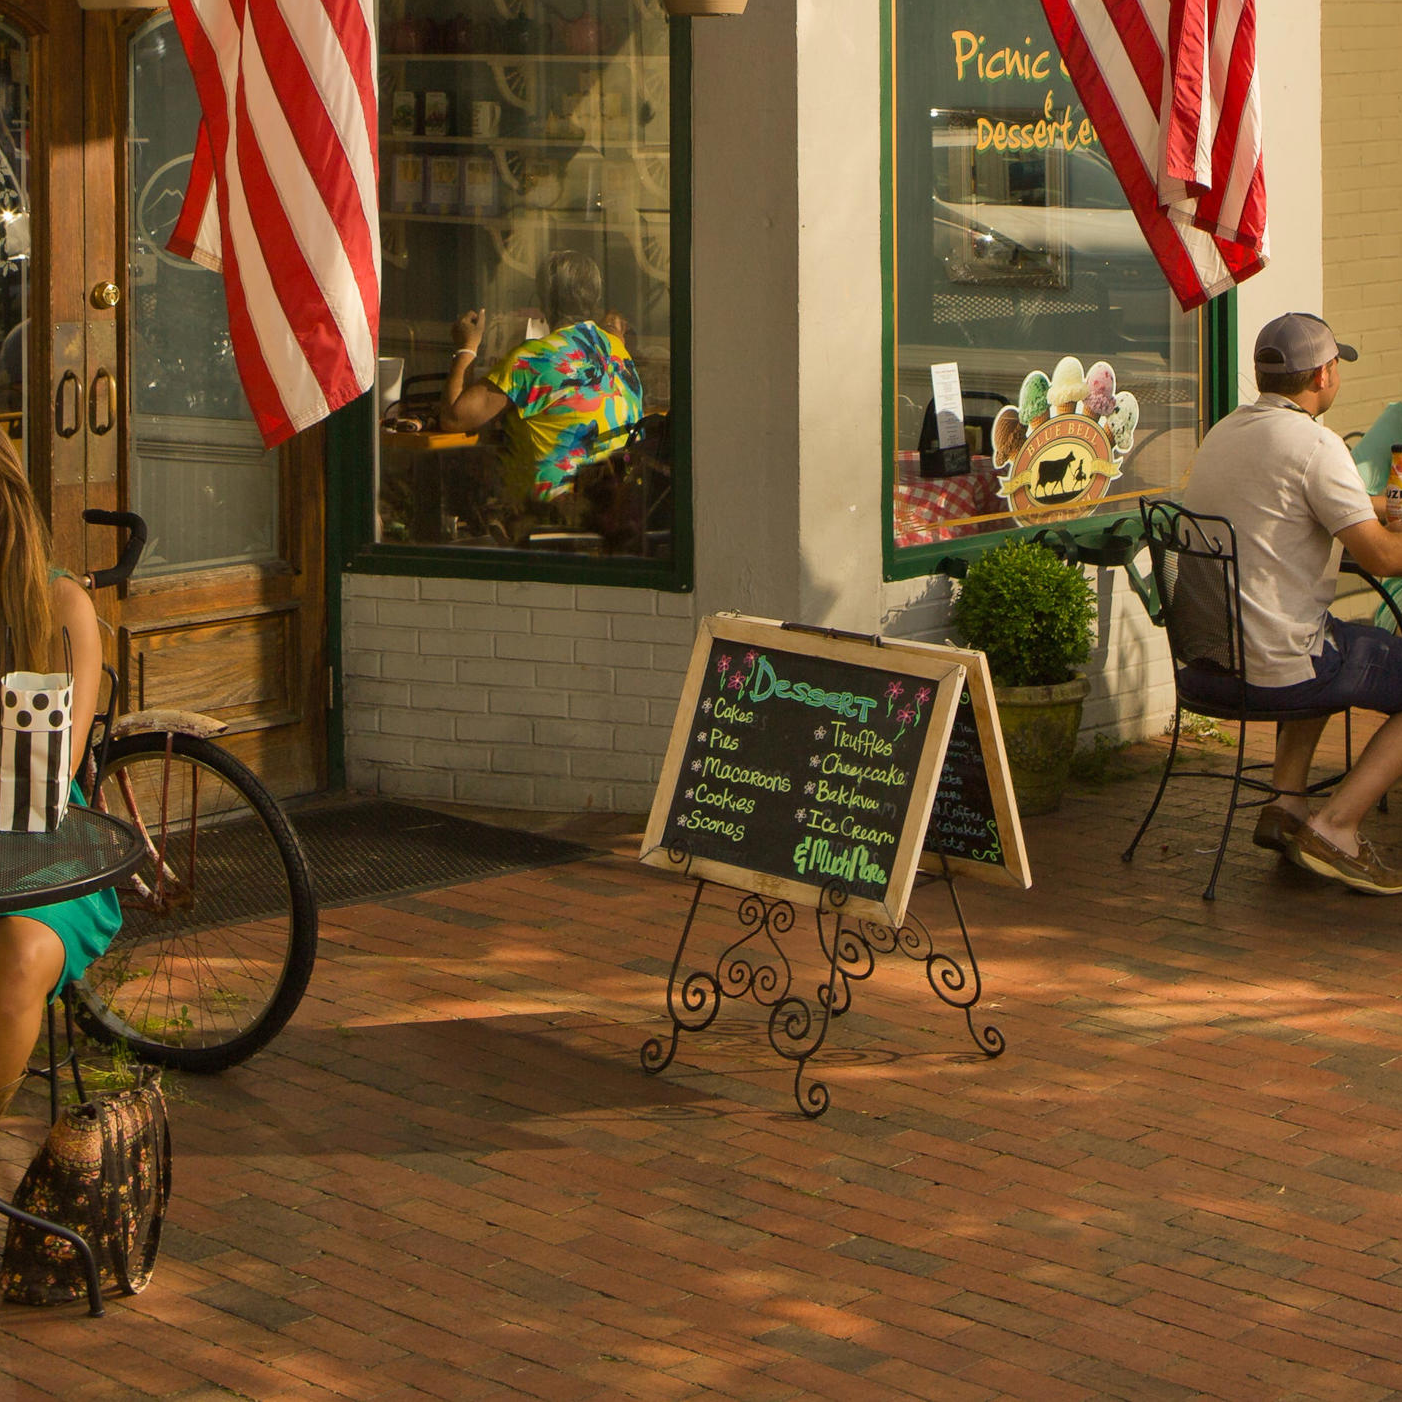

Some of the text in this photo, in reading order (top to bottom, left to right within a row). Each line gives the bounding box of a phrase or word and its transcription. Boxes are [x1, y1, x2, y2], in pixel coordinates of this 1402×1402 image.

[951, 29, 1051, 84] Picnic
[1026, 420, 1099, 458] BLUE BELL
[713, 697, 754, 724] Cakes
[709, 728, 739, 751] Pies
[695, 783, 756, 814] Cookies
[686, 810, 746, 842] Scones
[806, 809, 840, 835] Ice
